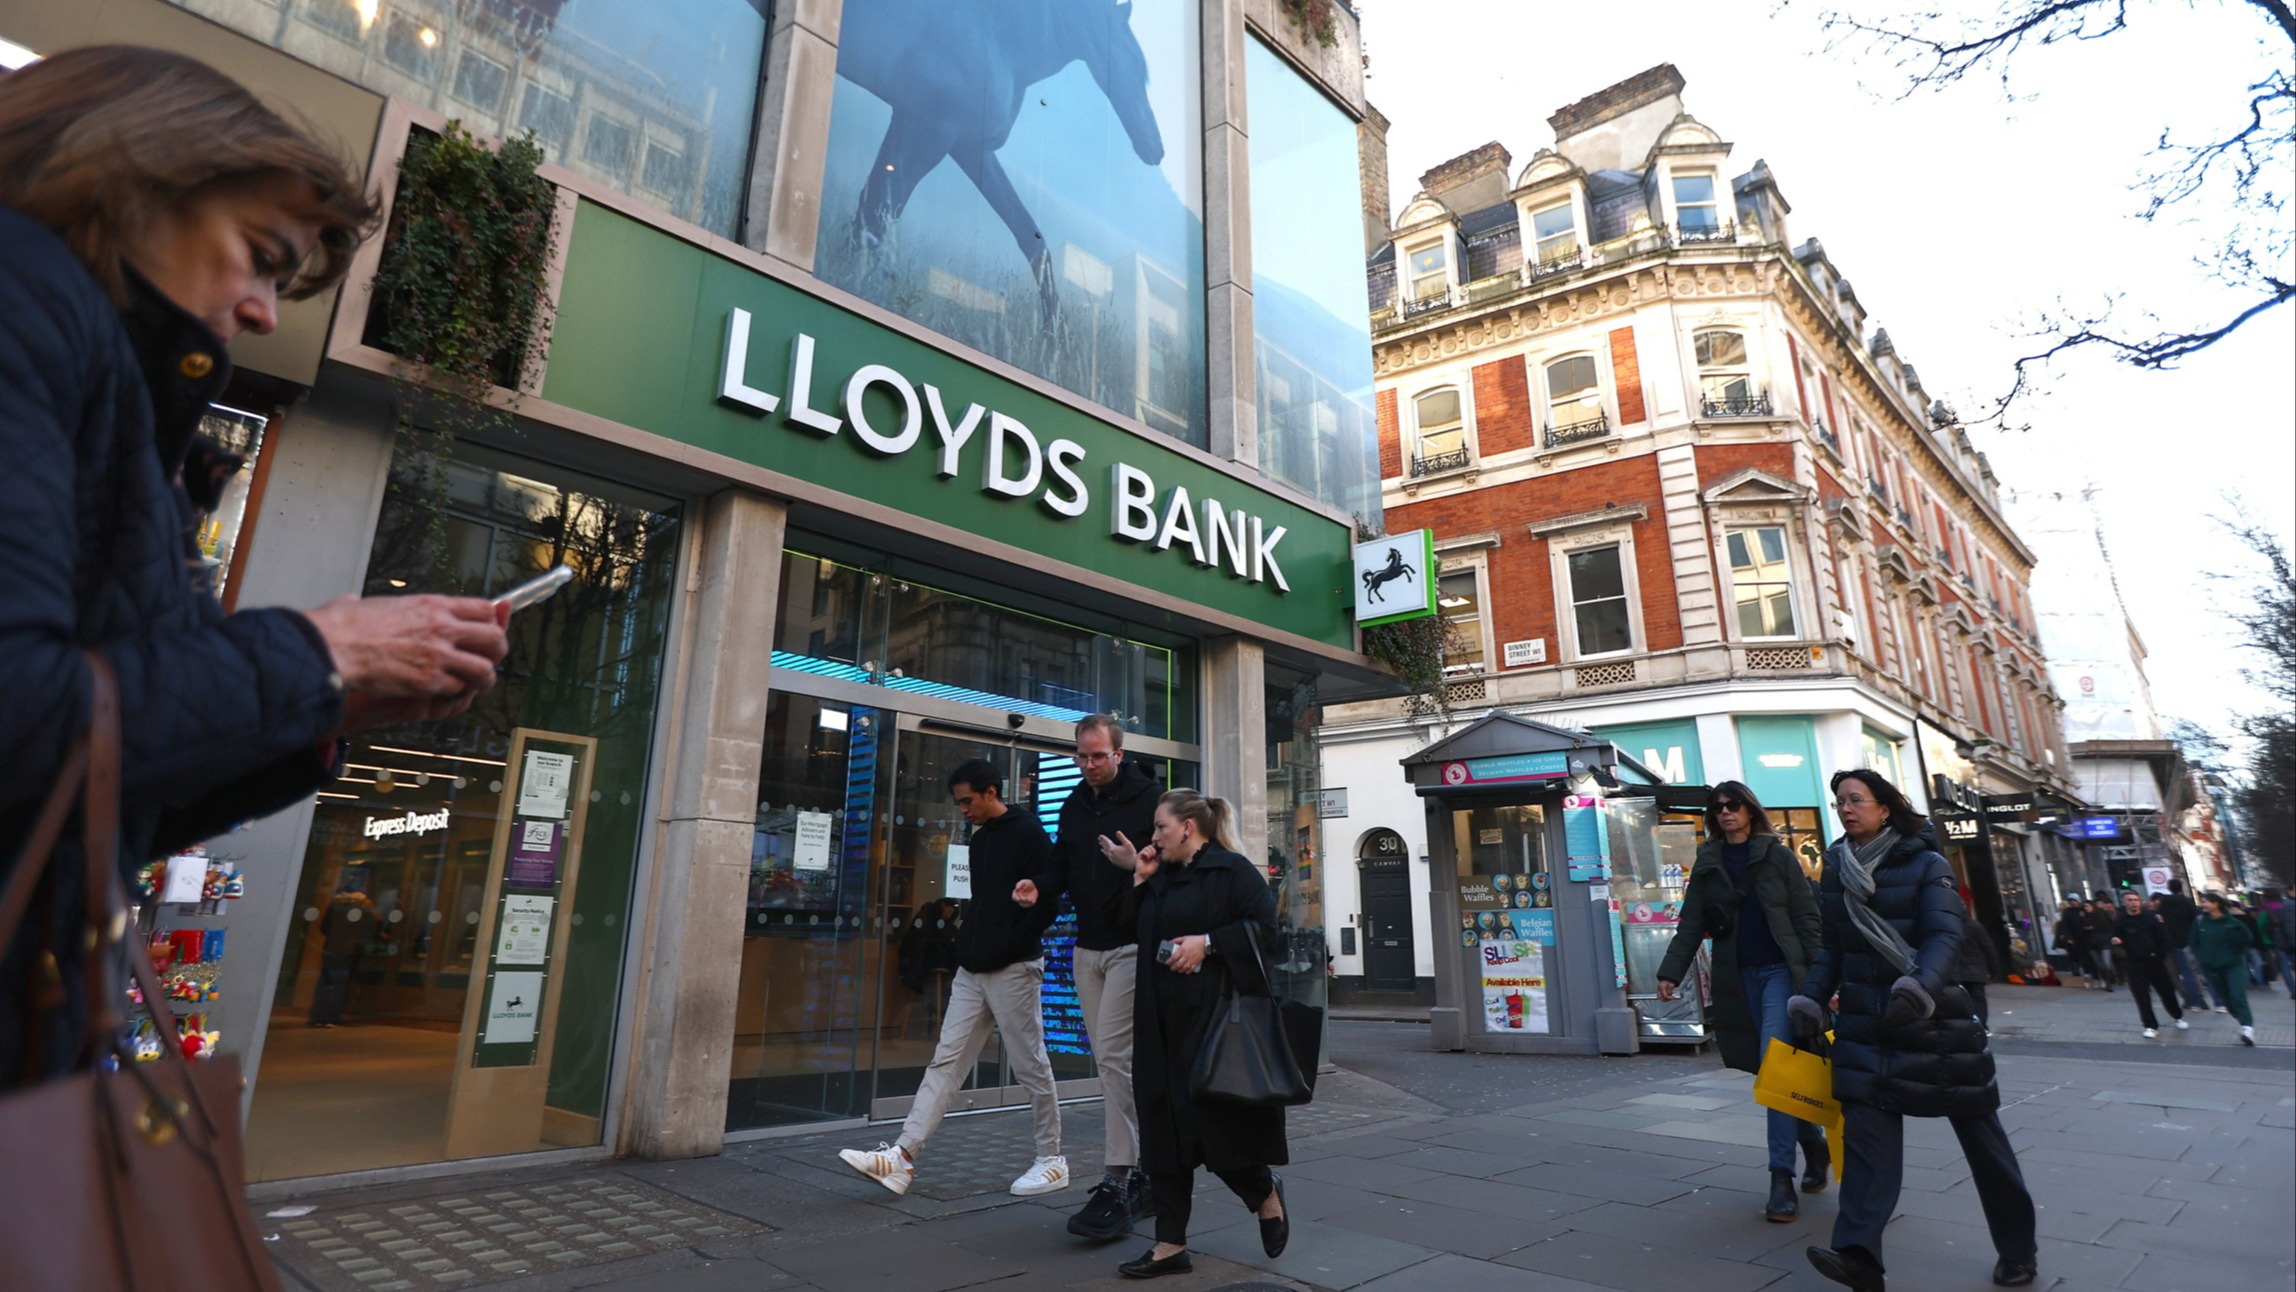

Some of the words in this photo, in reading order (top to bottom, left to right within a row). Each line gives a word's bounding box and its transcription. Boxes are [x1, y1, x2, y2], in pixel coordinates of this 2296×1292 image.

[717, 306, 1090, 518] LLOYDS
[1111, 462, 1291, 595] BANK
[1508, 643, 1531, 651] BINNEY
[1508, 650, 1531, 659] STREET
[1506, 766, 1533, 774] WAFFLES
[1986, 803, 2032, 813] INGLOT
[363, 815, 406, 841] Express
[405, 807, 450, 837] Deposit
[1379, 836, 1397, 851] 30
[951, 863, 970, 871] PLEAS
[953, 874, 969, 883] PUSH
[1461, 884, 1489, 894] Bubble
[1463, 892, 1495, 902] Waffles
[1520, 918, 1552, 930] Belgian
[1520, 927, 1553, 937] Waffles
[1486, 958, 1504, 966] Keep
[1486, 978, 1520, 987] Available
[1521, 978, 1542, 987] Here
[1791, 1091, 1824, 1109] SELFRIDGES
